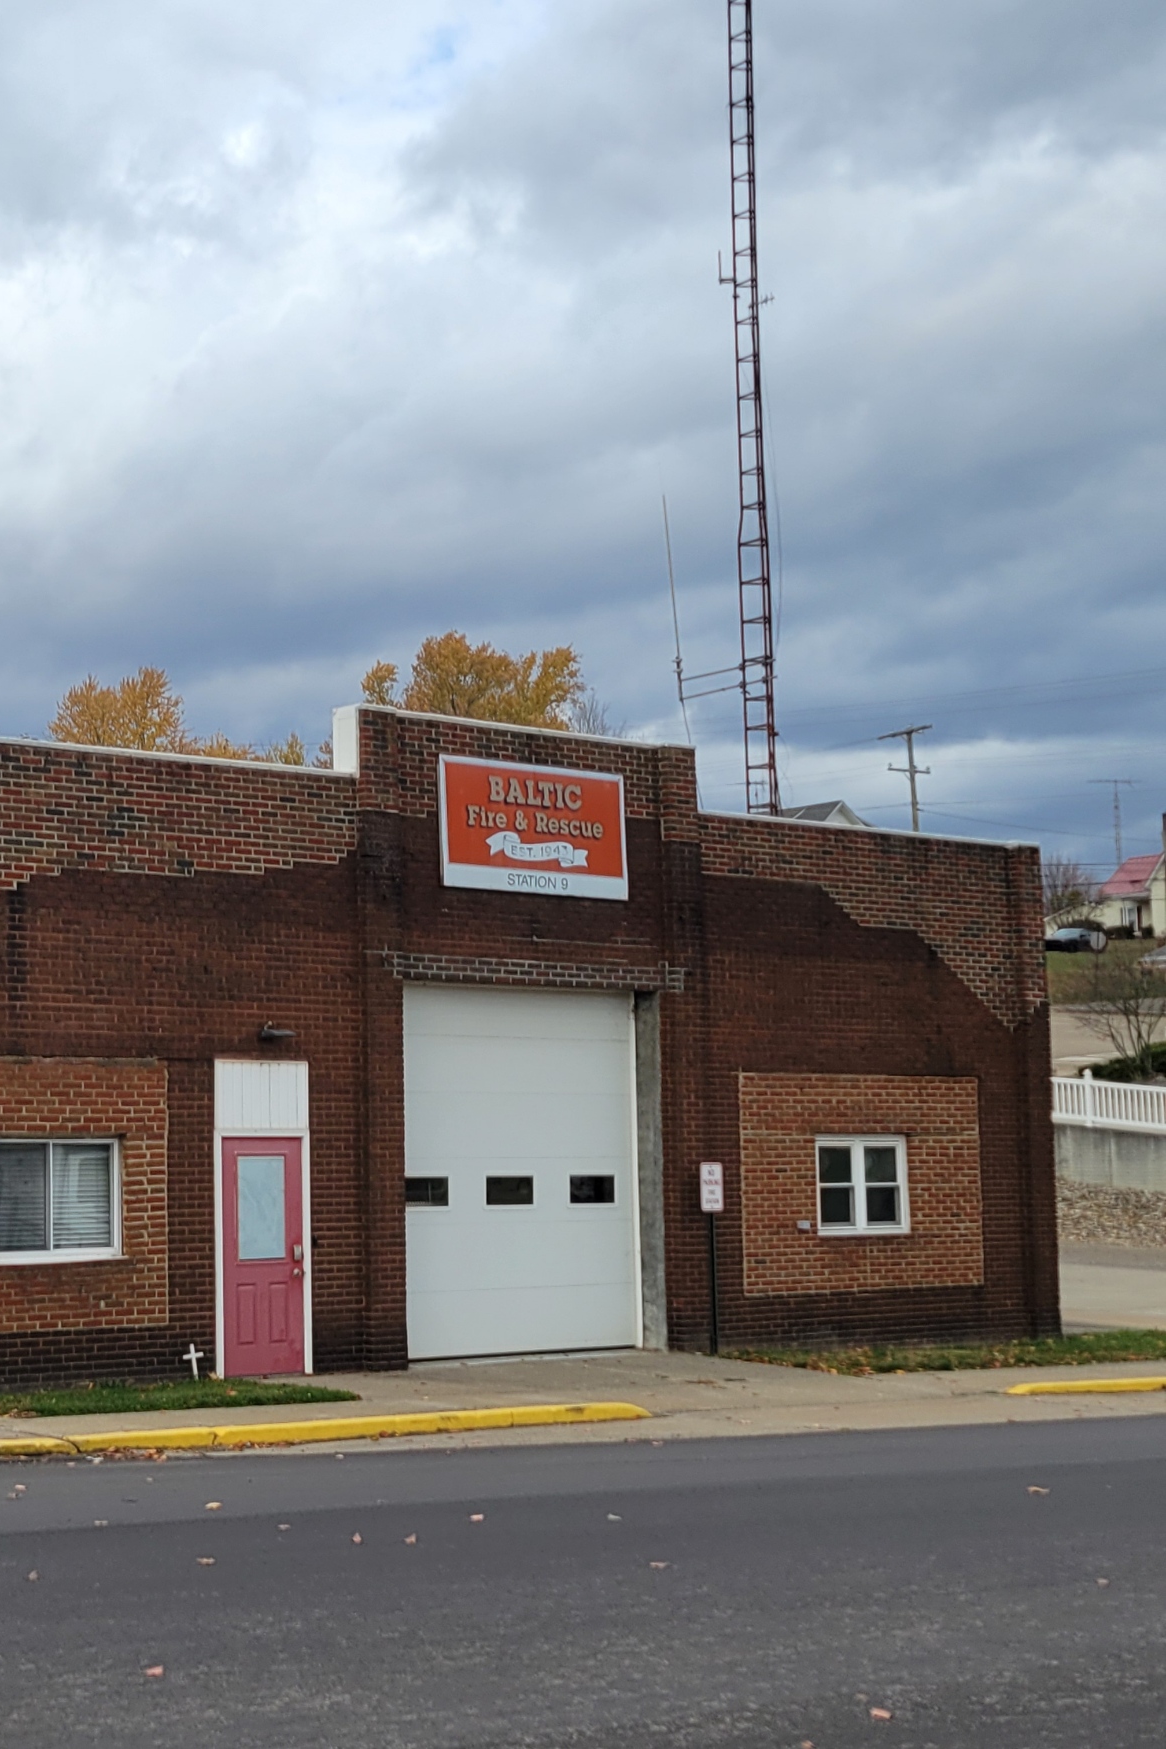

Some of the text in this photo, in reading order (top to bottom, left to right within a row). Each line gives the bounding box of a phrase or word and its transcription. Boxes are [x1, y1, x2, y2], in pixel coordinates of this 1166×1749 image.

[488, 775, 582, 811] BALTIC
[467, 804, 604, 839] Fire & Rescue
[511, 844, 569, 858] EST. 1943
[507, 873, 569, 890] STATION 9
